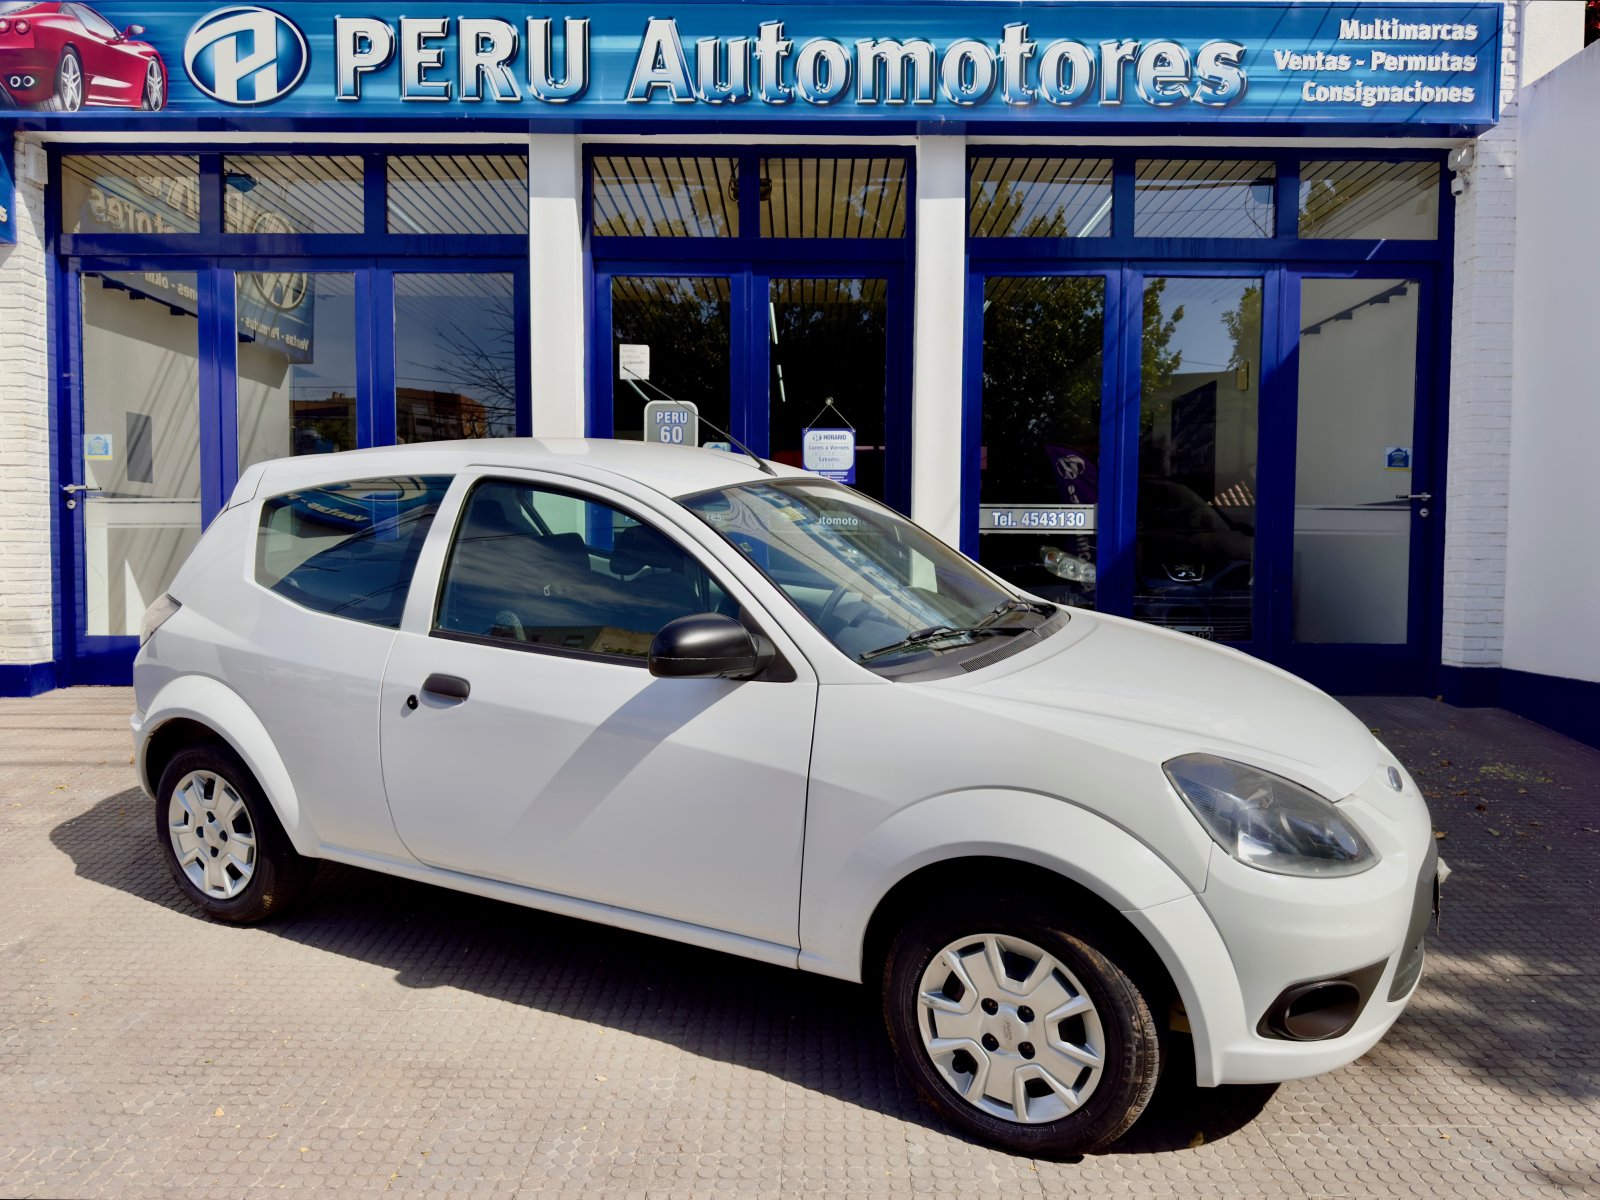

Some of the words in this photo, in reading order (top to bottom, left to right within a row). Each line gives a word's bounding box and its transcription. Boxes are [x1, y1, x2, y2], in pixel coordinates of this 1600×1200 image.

[1338, 17, 1479, 41] Multimarcas
[334, 15, 592, 103] PERU
[625, 16, 1249, 107] Automotores
[1273, 48, 1352, 72] Ventas
[1369, 50, 1478, 72] Permutas
[1302, 79, 1476, 107] Consignaciones
[656, 411, 689, 425] PERU
[660, 425, 684, 443] 60
[992, 511, 1017, 526] Tel.
[1021, 511, 1086, 527] 4543130
